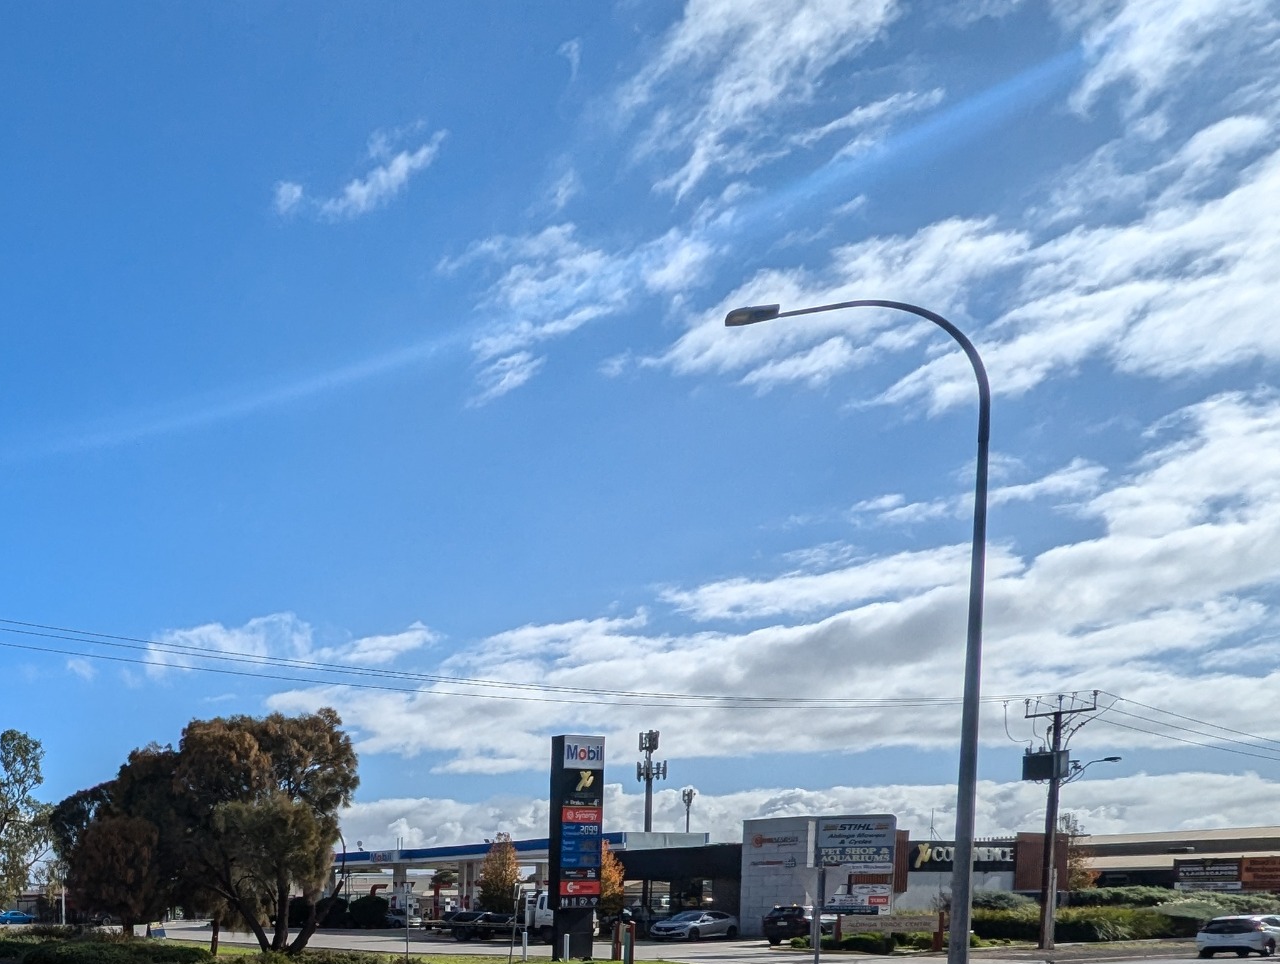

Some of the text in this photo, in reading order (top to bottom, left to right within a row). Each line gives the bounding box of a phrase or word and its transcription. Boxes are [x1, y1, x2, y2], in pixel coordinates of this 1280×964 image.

[566, 744, 603, 761] Mobil
[838, 823, 873, 831] STIHL
[845, 847, 877, 855] SHOP
[370, 852, 393, 862] Mobil
[820, 855, 890, 863] AQUARIUMS
